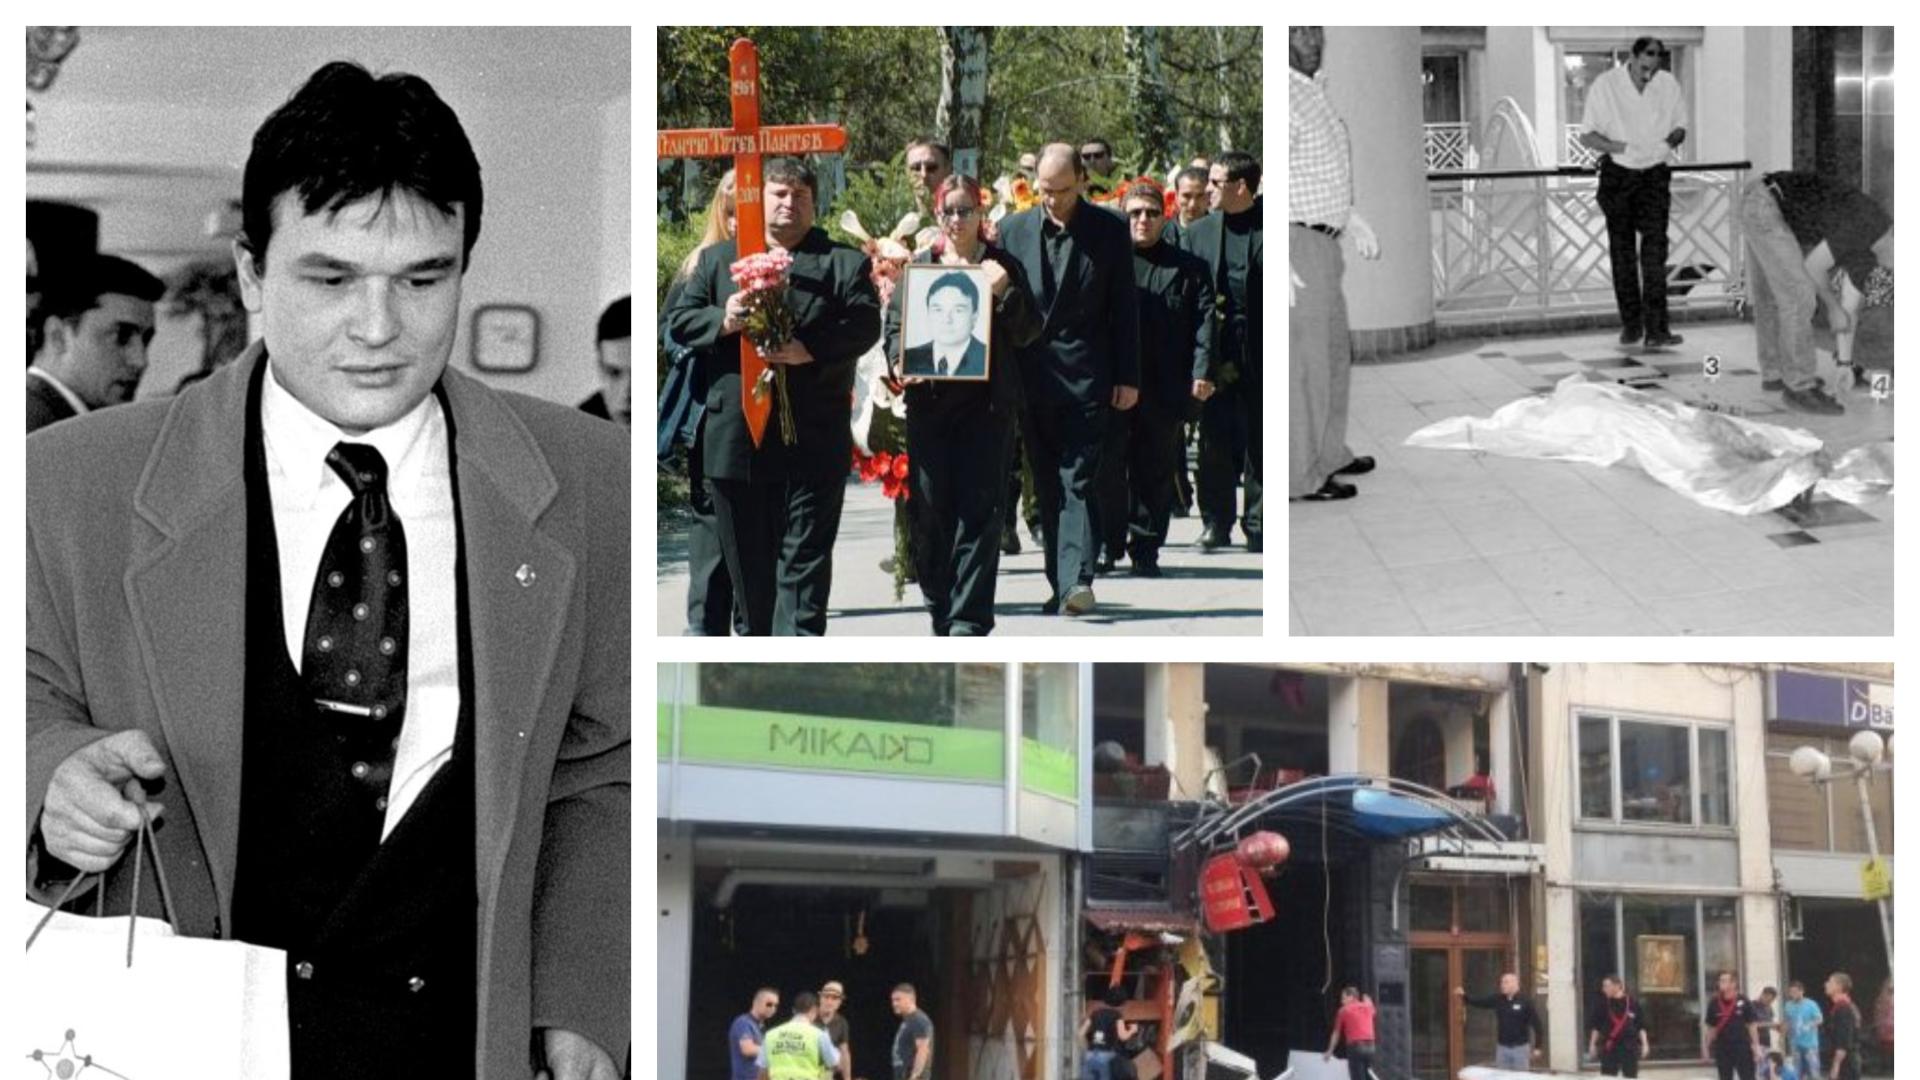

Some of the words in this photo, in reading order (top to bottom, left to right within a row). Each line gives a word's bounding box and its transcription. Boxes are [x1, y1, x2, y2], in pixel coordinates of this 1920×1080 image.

[1705, 357, 1719, 375] 3
[1873, 375, 1887, 395] 4
[769, 723, 934, 765] MIKADO
